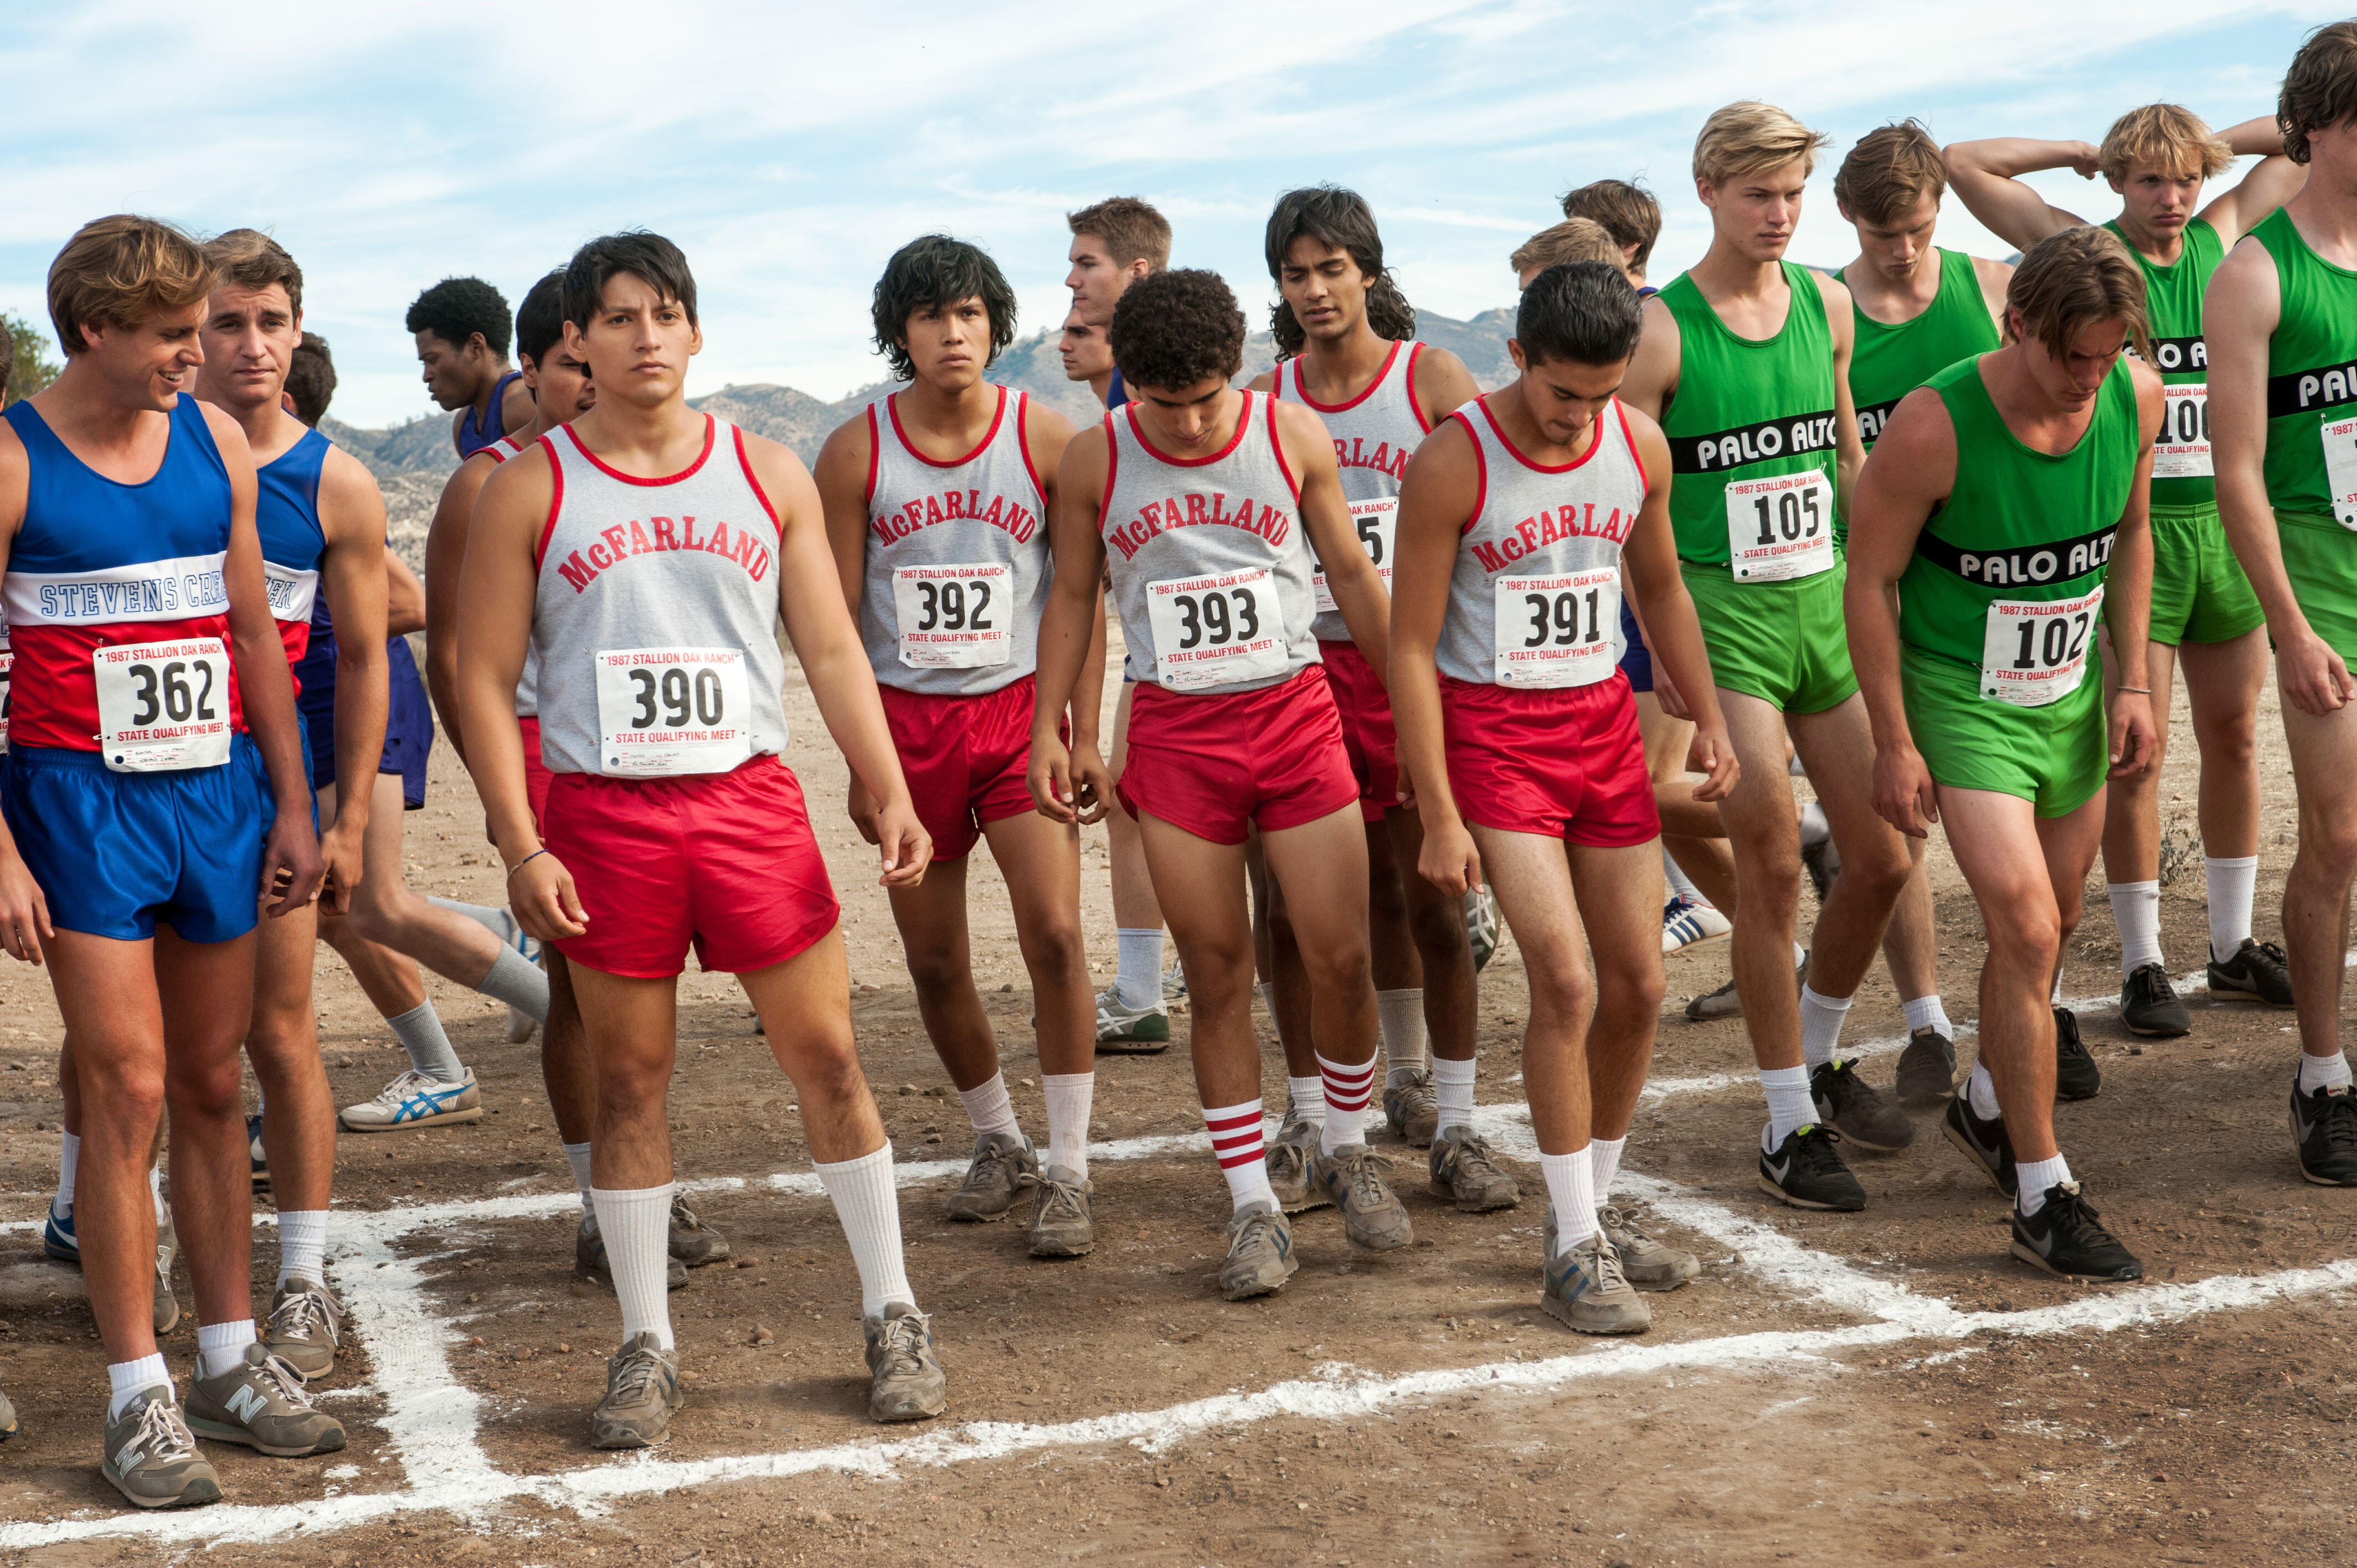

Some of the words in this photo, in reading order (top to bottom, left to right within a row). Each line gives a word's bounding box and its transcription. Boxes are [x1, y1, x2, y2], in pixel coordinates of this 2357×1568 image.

[2331, 423, 2353, 435] 1987
[1332, 437, 1413, 482] RLAN
[1698, 426, 1783, 469] PALO
[2168, 445, 2209, 454] QUALIFYING
[1735, 484, 1754, 494] 1987
[1756, 479, 1793, 493] STALLION
[1794, 477, 1807, 487] OAK
[1808, 473, 1823, 485] RANCH
[871, 489, 1036, 547] McFARLAND
[1350, 505, 1363, 515] AK
[1365, 502, 1393, 513] RANCH
[1754, 487, 1819, 545] 105
[1109, 492, 1289, 562] McFARLAND
[557, 515, 770, 594] McFARLAND
[1744, 548, 1768, 558] STATE
[1771, 540, 1811, 556] QUALIFYING
[1812, 535, 1825, 547] MEET
[1960, 551, 2057, 584] PALO
[2069, 532, 2116, 575] ALT
[899, 570, 917, 579] 1987
[919, 569, 957, 579] STALLION
[959, 568, 976, 578] OAK
[977, 567, 1005, 576] RANCH
[1155, 584, 1174, 595] 1987
[1176, 579, 1217, 592] STALLION
[1219, 575, 1237, 587] OAK
[1238, 570, 1265, 584] RANCH
[1506, 580, 1527, 591] 1987
[1530, 578, 1571, 590] STALLION
[1573, 576, 1590, 587] OAK
[1591, 571, 1614, 585] RANCH
[40, 576, 178, 617] STEVENS
[184, 570, 227, 607] CRE
[917, 580, 992, 631] 392
[1999, 605, 2021, 615] 1987
[2023, 605, 2065, 616] STALLION
[2066, 602, 2083, 613] OAK
[2084, 591, 2101, 608] RANCH
[1174, 587, 1259, 649] 393
[1525, 588, 1600, 647] 391
[908, 633, 929, 643] STATE
[931, 633, 979, 642] QUALIFYING
[981, 631, 1002, 641] MEET
[2013, 611, 2090, 669] 102
[105, 650, 130, 663] 1987
[132, 647, 180, 661] STALLION
[181, 645, 198, 658] OAK
[199, 643, 221, 655] RANCH
[607, 655, 630, 666] 1987
[633, 653, 681, 665] STALLION
[683, 653, 703, 664] OAK
[704, 653, 734, 664] RANCH
[1168, 652, 1194, 663] STATE
[1196, 643, 1248, 661] QUALIFYING
[1250, 639, 1273, 652] MEET
[1509, 651, 1536, 661] STATE
[1539, 646, 1590, 660] QUALIFYING
[1592, 641, 1607, 653] MEET
[1996, 669, 2024, 680] STATE
[2026, 664, 2071, 681] QUALIFYING
[2072, 654, 2085, 669] MEET
[128, 659, 215, 726] 362
[629, 667, 724, 729] 390
[117, 729, 150, 742] STATE
[152, 723, 207, 740] QUALIFYING
[208, 721, 224, 734] MEET
[616, 733, 646, 744] STATE
[648, 730, 708, 742] QUALIFYING
[711, 729, 736, 741] MEET
